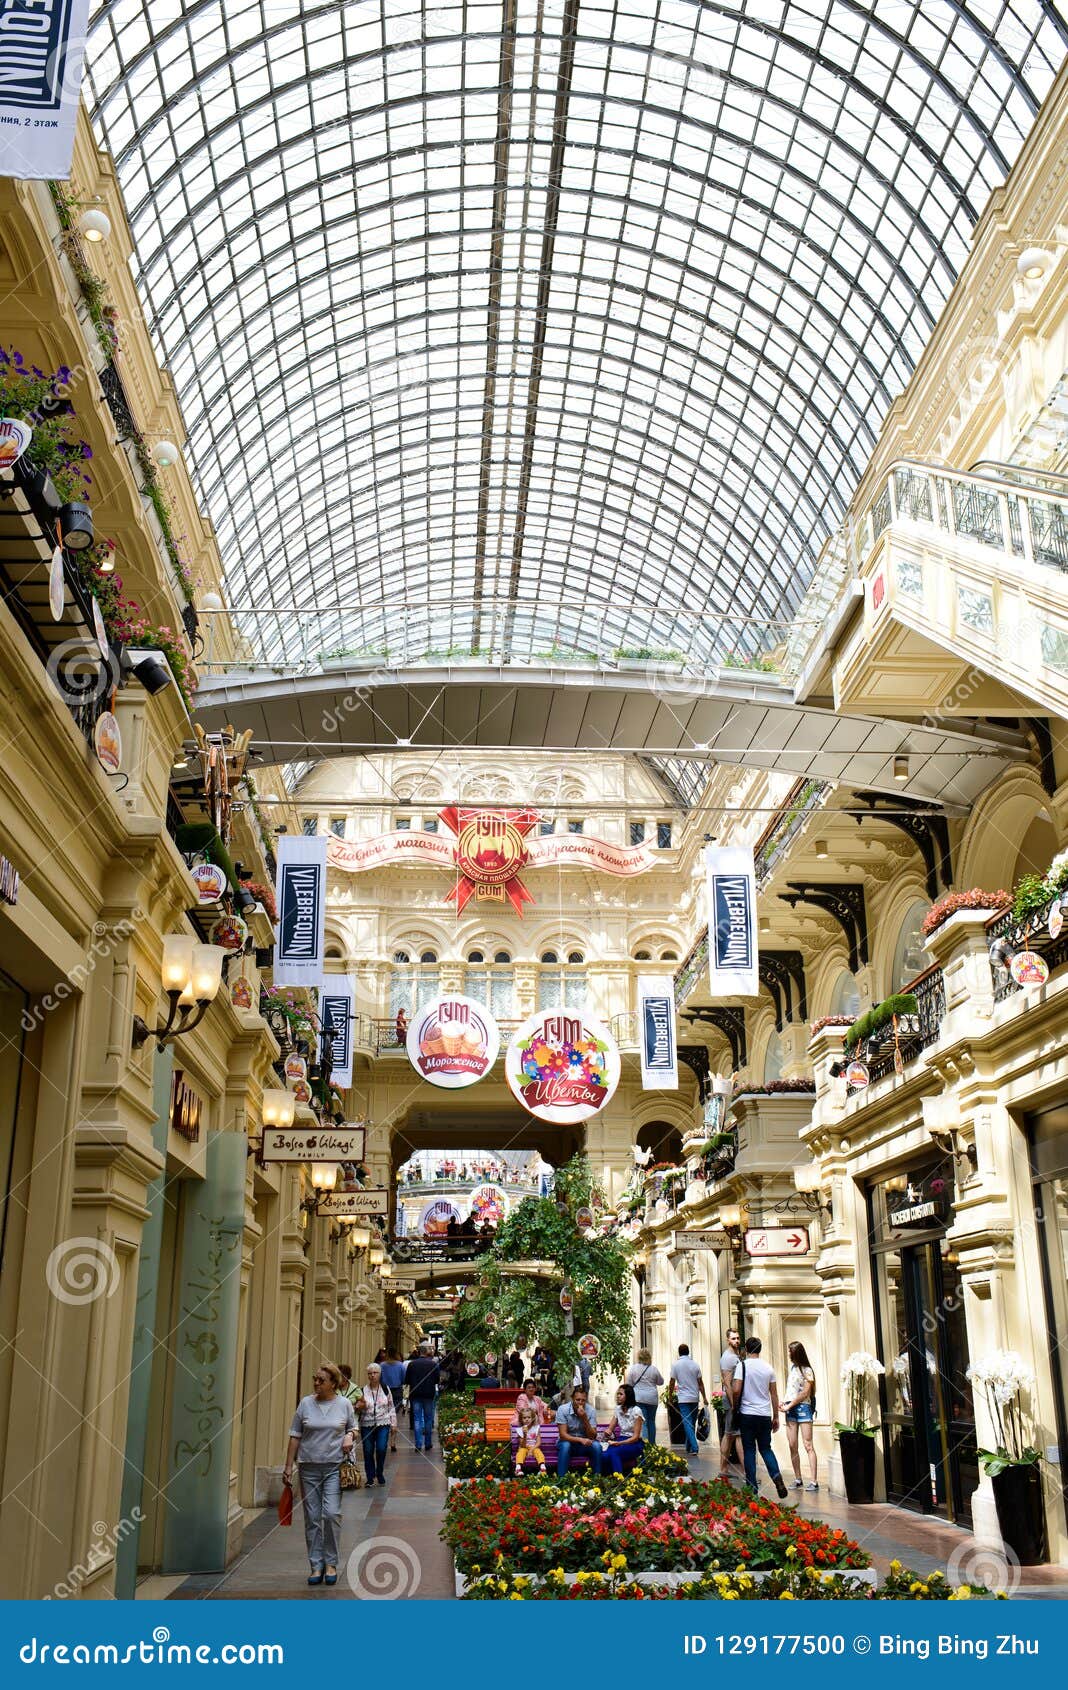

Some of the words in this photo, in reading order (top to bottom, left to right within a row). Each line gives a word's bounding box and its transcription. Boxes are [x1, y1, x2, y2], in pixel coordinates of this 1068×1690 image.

[25, 118, 30, 127] 2
[34, 119, 58, 128] этаж
[331, 843, 387, 861] Главный
[393, 839, 449, 855] магазин
[547, 844, 596, 858] Красной
[597, 850, 645, 869] площади
[462, 861, 489, 881] КРАСНАЯ
[478, 885, 502, 896] GUM
[287, 869, 315, 955] VILEBREQUIN
[716, 879, 747, 966] VILEBREQUIN
[438, 1002, 470, 1024] ГУМ
[544, 1016, 582, 1044] ГУМ
[650, 1000, 669, 1068] VILEBREQUIN
[424, 1056, 484, 1071] Мороженое
[523, 1072, 600, 1107] Цветы
